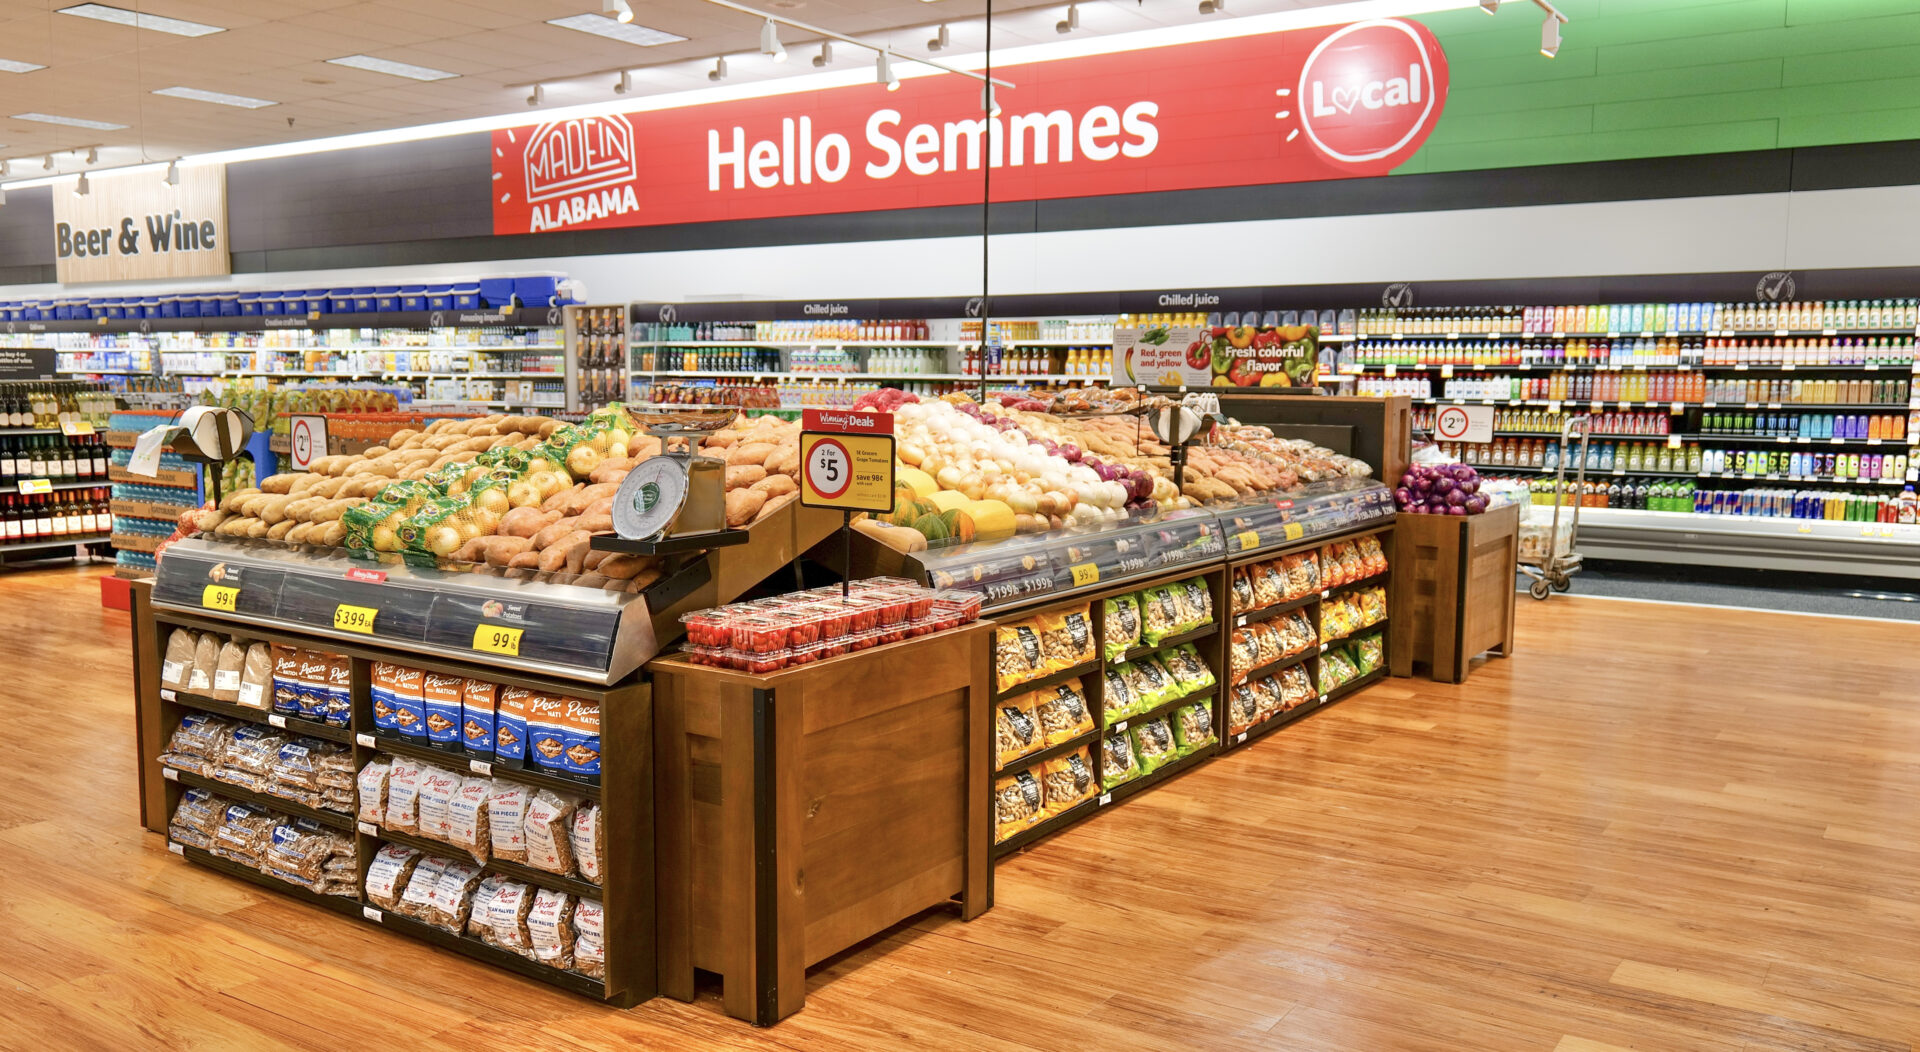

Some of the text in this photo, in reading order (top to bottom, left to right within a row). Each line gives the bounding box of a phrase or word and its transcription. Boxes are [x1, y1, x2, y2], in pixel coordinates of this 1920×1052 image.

[708, 101, 1159, 191] Hello Semmes
[530, 185, 640, 233] ALABAMA
[56, 209, 216, 258] Beer & Wine
[1158, 294, 1220, 307] Chilled juice
[803, 304, 849, 316] Chilled juice
[459, 313, 483, 324] Amazing
[1140, 349, 1182, 360] Red, green
[1225, 345, 1304, 358] Fresh colorful
[1140, 359, 1182, 369] and yellow
[1246, 359, 1281, 372] flavor
[820, 412, 874, 430] Winning Deals
[820, 459, 838, 481] $5
[871, 474, 883, 482] 98¢
[335, 609, 365, 626] $399
[299, 662, 326, 676] Pecan
[424, 674, 462, 688] Pecan
[465, 680, 493, 693] Pecan
[530, 697, 561, 713] Peca
[565, 700, 600, 717] Peca
[580, 717, 600, 725] NATIO
